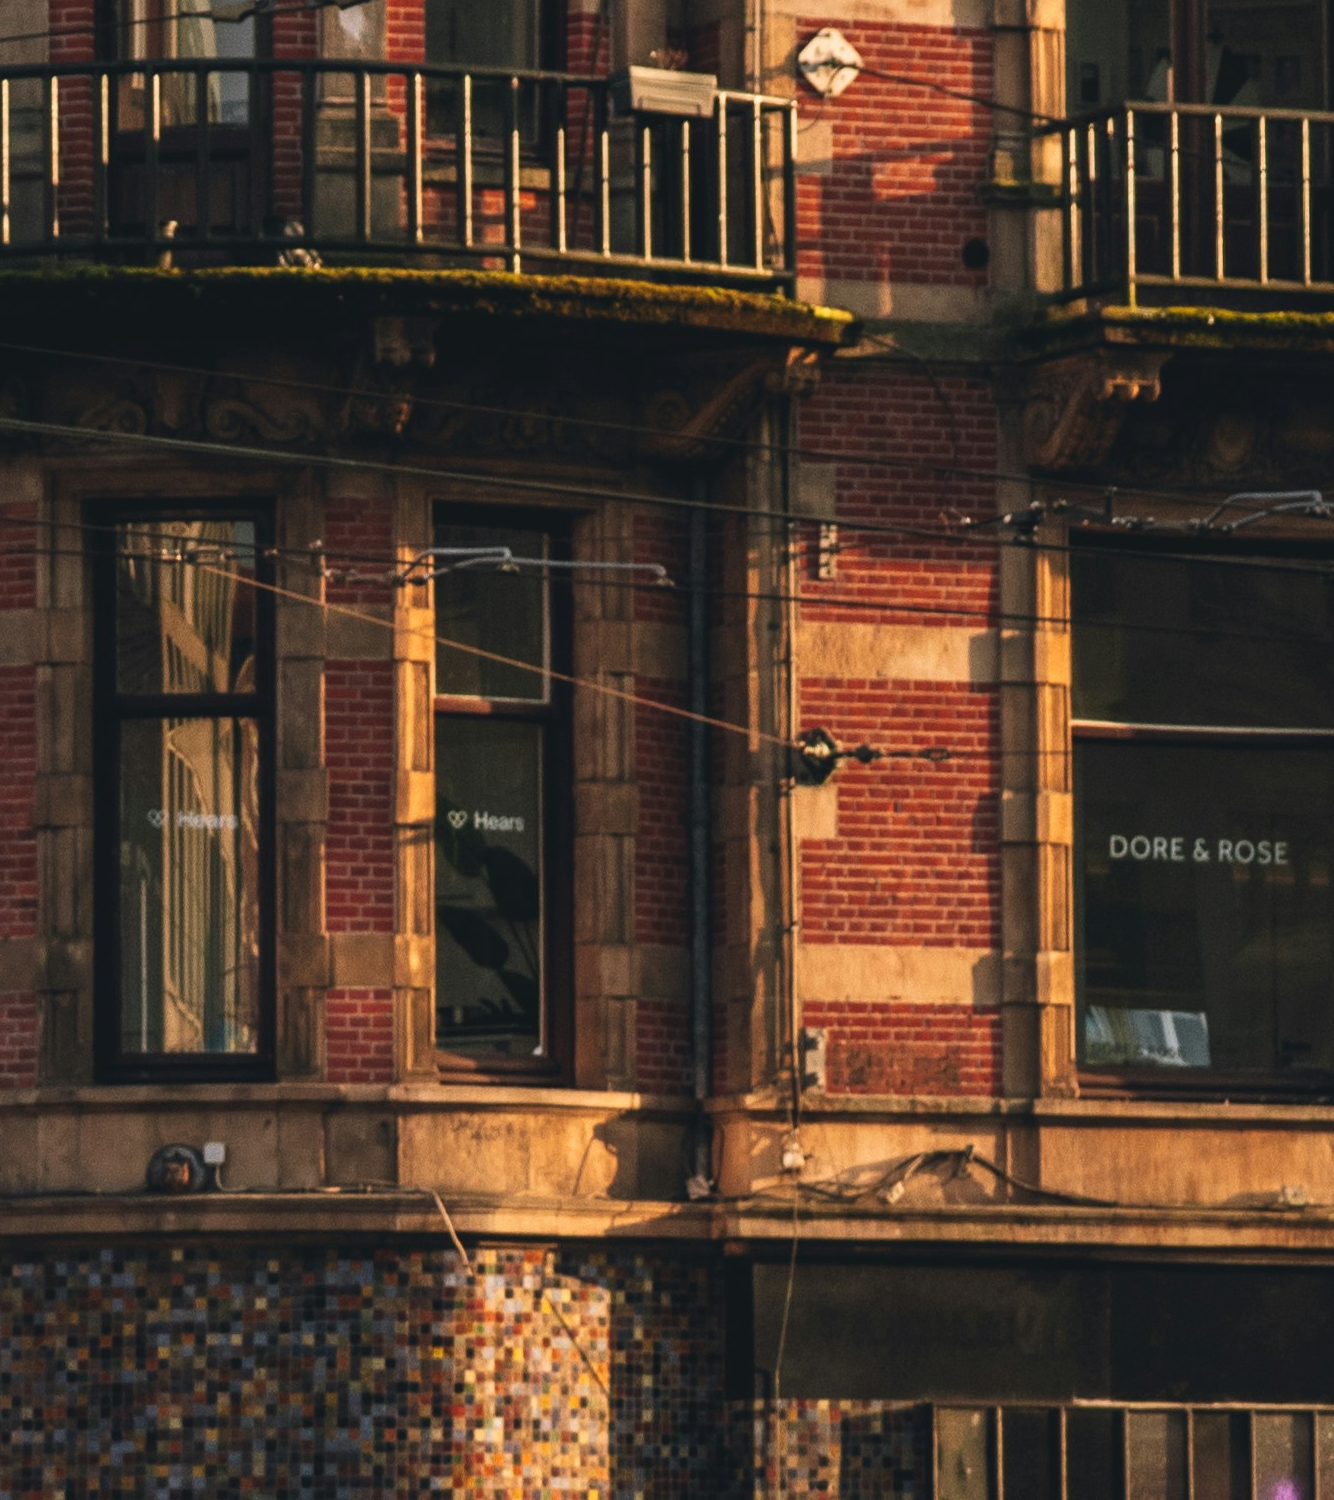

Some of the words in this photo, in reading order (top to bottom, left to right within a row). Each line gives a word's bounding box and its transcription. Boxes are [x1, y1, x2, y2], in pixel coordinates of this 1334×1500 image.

[473, 811, 525, 832] Hears
[1109, 834, 1185, 862] DORE
[1192, 837, 1211, 863] &
[1218, 839, 1289, 865] ROSE
